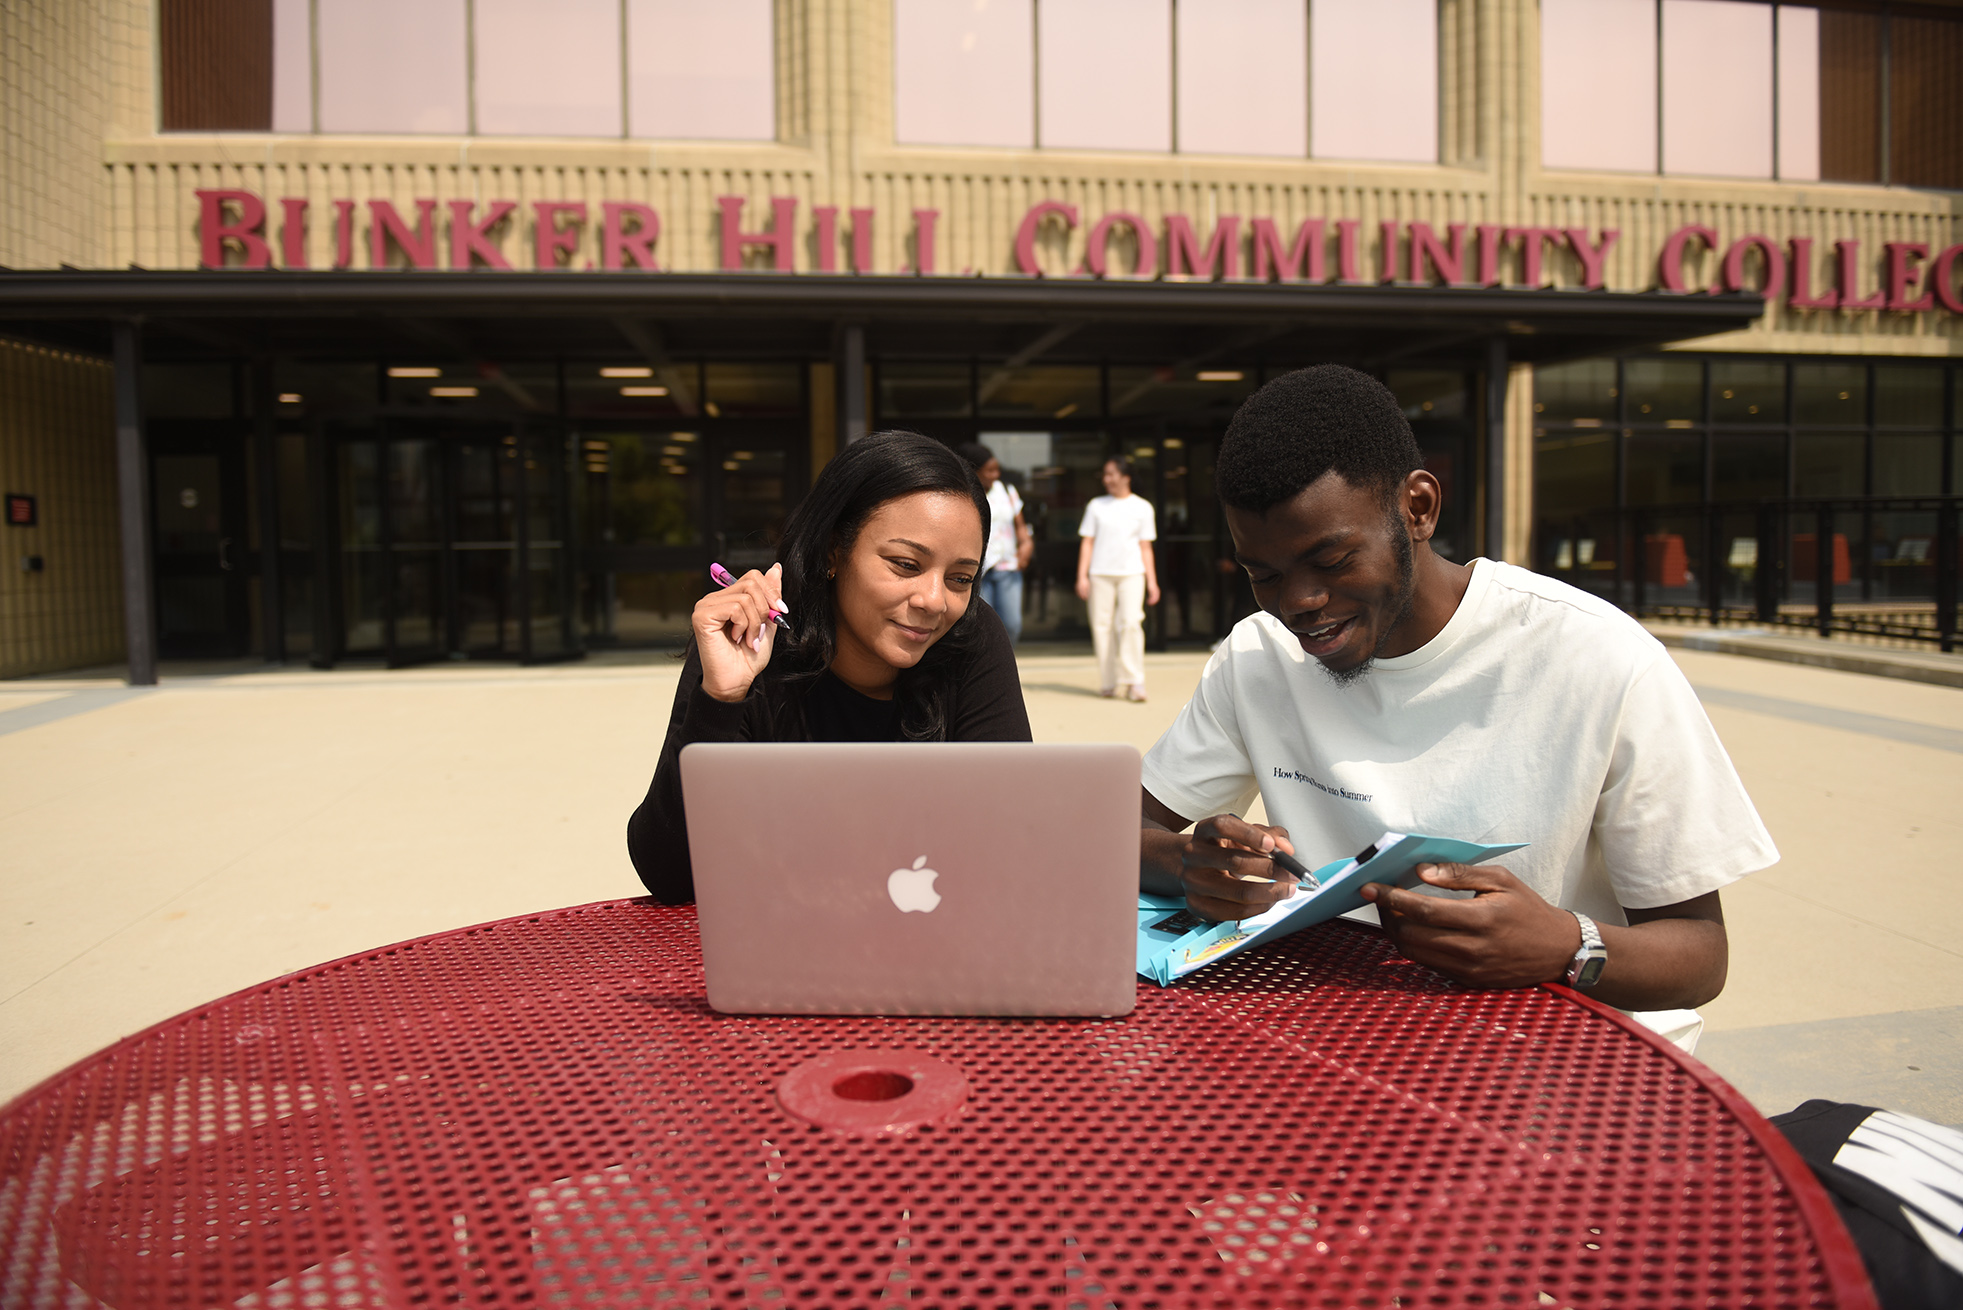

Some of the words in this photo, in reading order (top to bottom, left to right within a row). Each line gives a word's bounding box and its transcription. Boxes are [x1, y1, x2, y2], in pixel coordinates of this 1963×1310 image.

[195, 188, 662, 270] BUNKER
[717, 196, 974, 274] HILL
[1015, 200, 1620, 288] COMMUNITY
[1273, 767, 1293, 779] How
[1340, 788, 1372, 802] Summer
